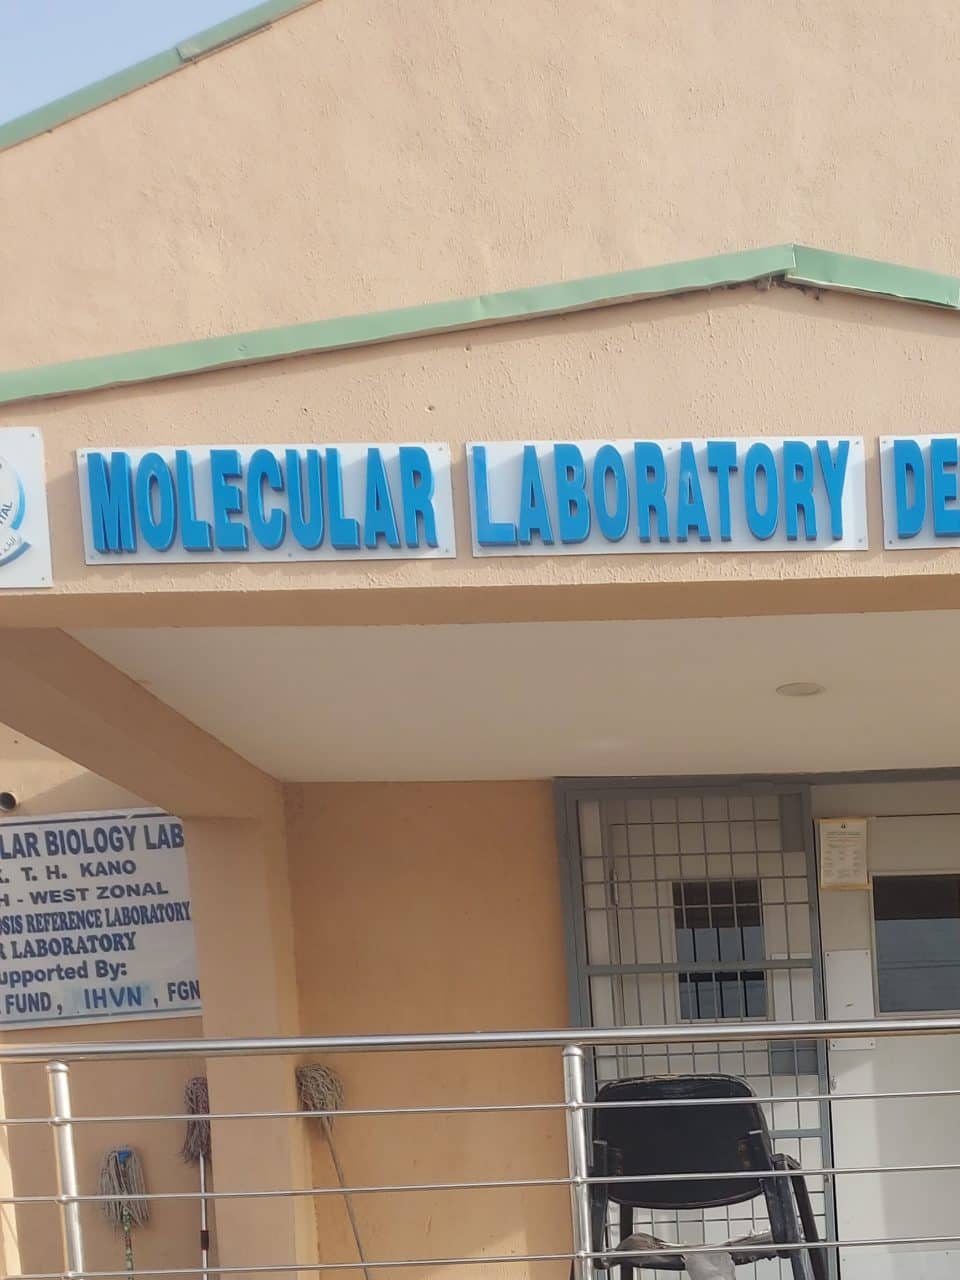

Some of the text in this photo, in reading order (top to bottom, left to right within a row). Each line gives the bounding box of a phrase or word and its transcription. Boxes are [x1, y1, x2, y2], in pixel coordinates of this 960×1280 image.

[87, 445, 438, 553] MOLECULAR
[472, 440, 849, 547] LABORATORY
[45, 825, 136, 856] BIOLOGY
[144, 823, 184, 850] LAB
[20, 866, 38, 882] T.
[46, 865, 68, 881] H.
[80, 860, 136, 878] KANO
[29, 887, 89, 905] WEST
[96, 882, 168, 900] ZONAL
[26, 908, 103, 934] REFERENCE
[105, 901, 191, 928] LABORATORY
[11, 932, 136, 959] LABORATORY
[95, 959, 127, 981] By:
[84, 986, 142, 1010] IHVN
[167, 980, 201, 1002] FGN
